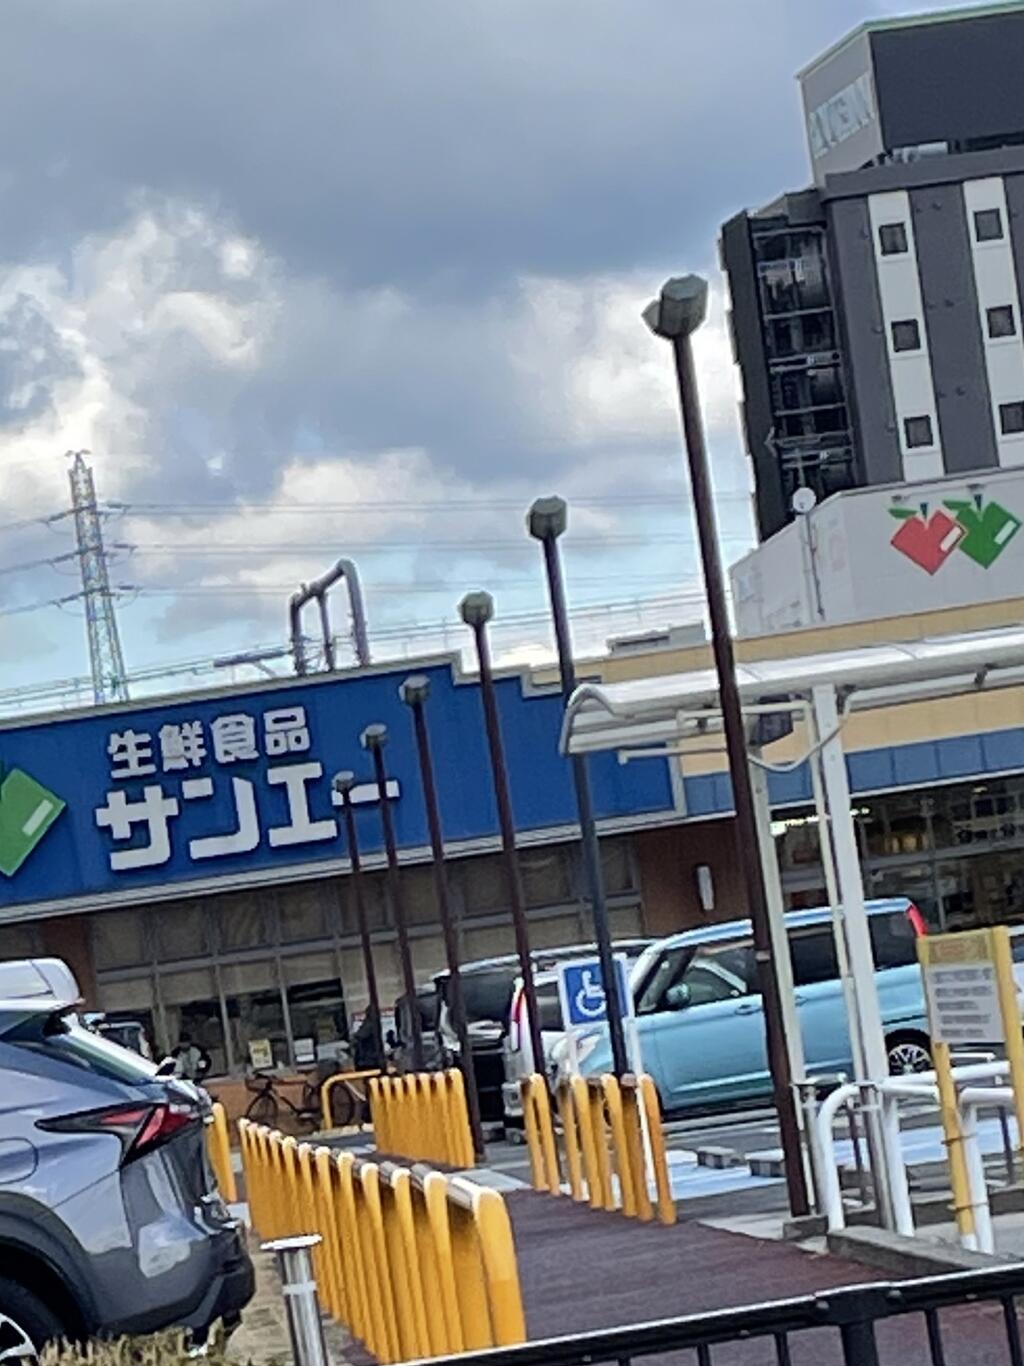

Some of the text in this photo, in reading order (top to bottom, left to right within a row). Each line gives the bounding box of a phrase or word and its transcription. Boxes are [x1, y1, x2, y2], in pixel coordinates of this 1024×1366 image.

[108, 706, 310, 778] 生鮮食品
[96, 762, 400, 870] サンエー
